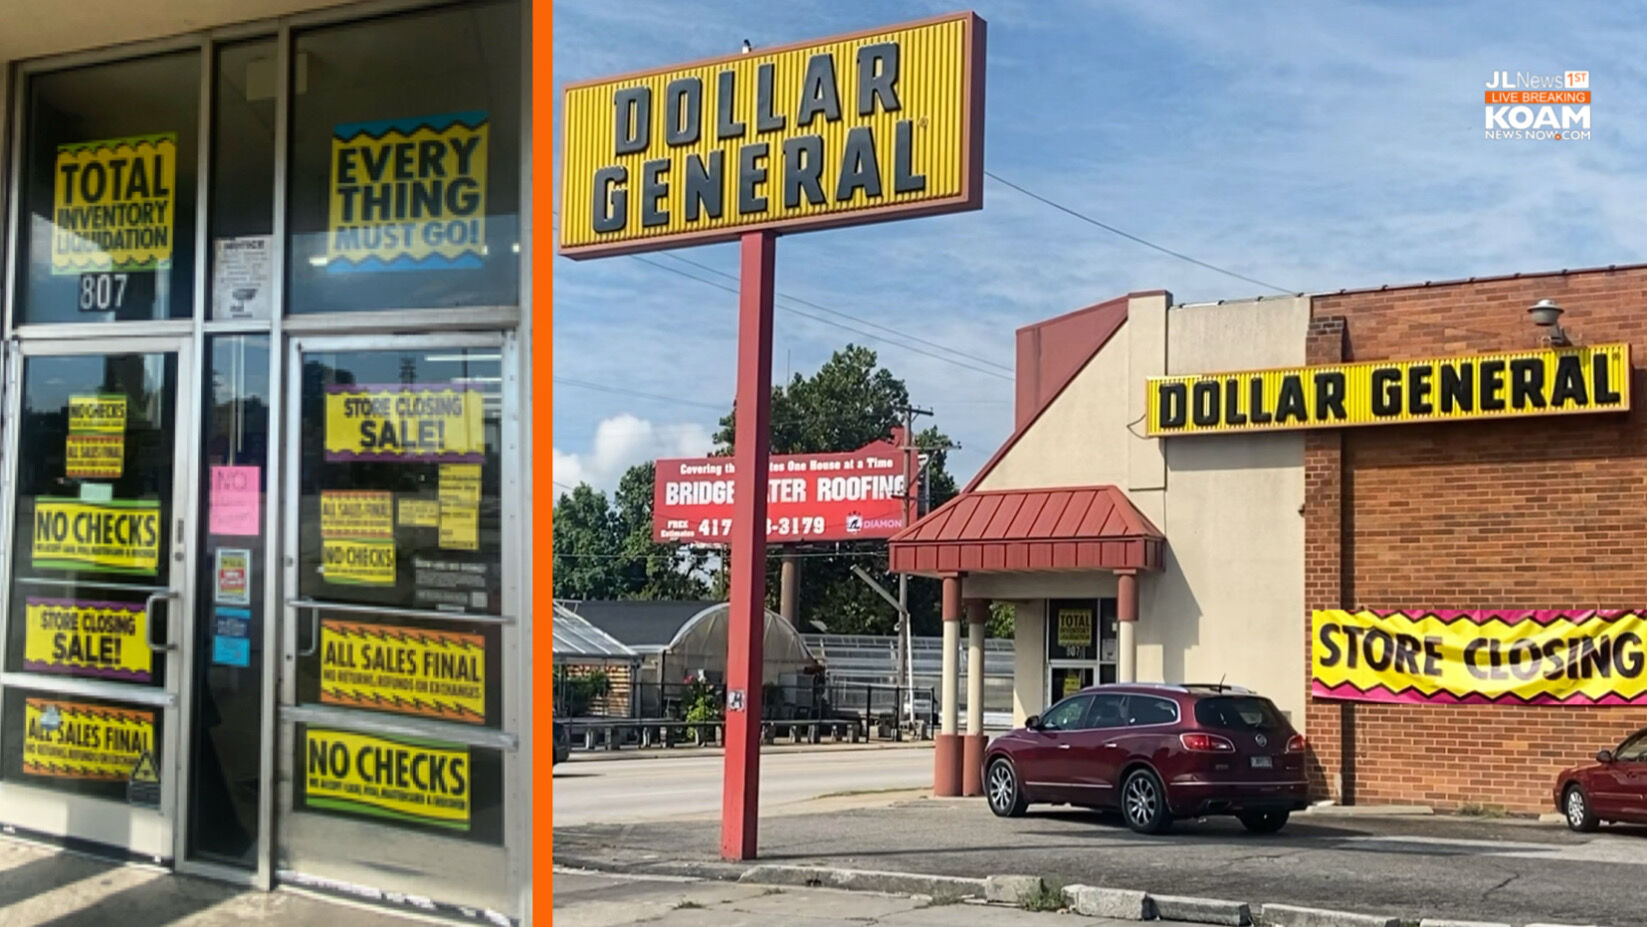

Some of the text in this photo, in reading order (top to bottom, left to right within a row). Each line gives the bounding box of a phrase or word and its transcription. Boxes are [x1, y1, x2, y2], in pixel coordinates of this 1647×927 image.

[613, 41, 901, 157] DOLLAR
[337, 135, 480, 184] EVERY
[592, 119, 927, 234] GENERAL
[60, 154, 170, 204] TOTAL
[57, 200, 169, 230] INVENTORY
[336, 177, 481, 223] THING
[335, 219, 478, 251] MUST GO!
[81, 273, 128, 309] 807
[344, 395, 463, 419] STORE CLOSING
[1159, 352, 1621, 429] DOLLAR GENERAL
[359, 418, 445, 450] SALE!
[680, 463, 722, 476] Covering
[725, 462, 735, 474] th
[787, 460, 806, 471] One
[810, 458, 841, 471] House
[867, 456, 893, 469] Time
[37, 511, 156, 547] NO CHECKS
[863, 519, 902, 529] DIAMON
[39, 610, 136, 636] STORE CLOSING
[51, 632, 122, 665] SALE!
[325, 641, 481, 682] ALL SALES FINAL
[1319, 623, 1645, 681] STORE CLOSING
[57, 721, 101, 748] SALES
[308, 737, 350, 779] NO
[355, 745, 466, 796] CHECKS
